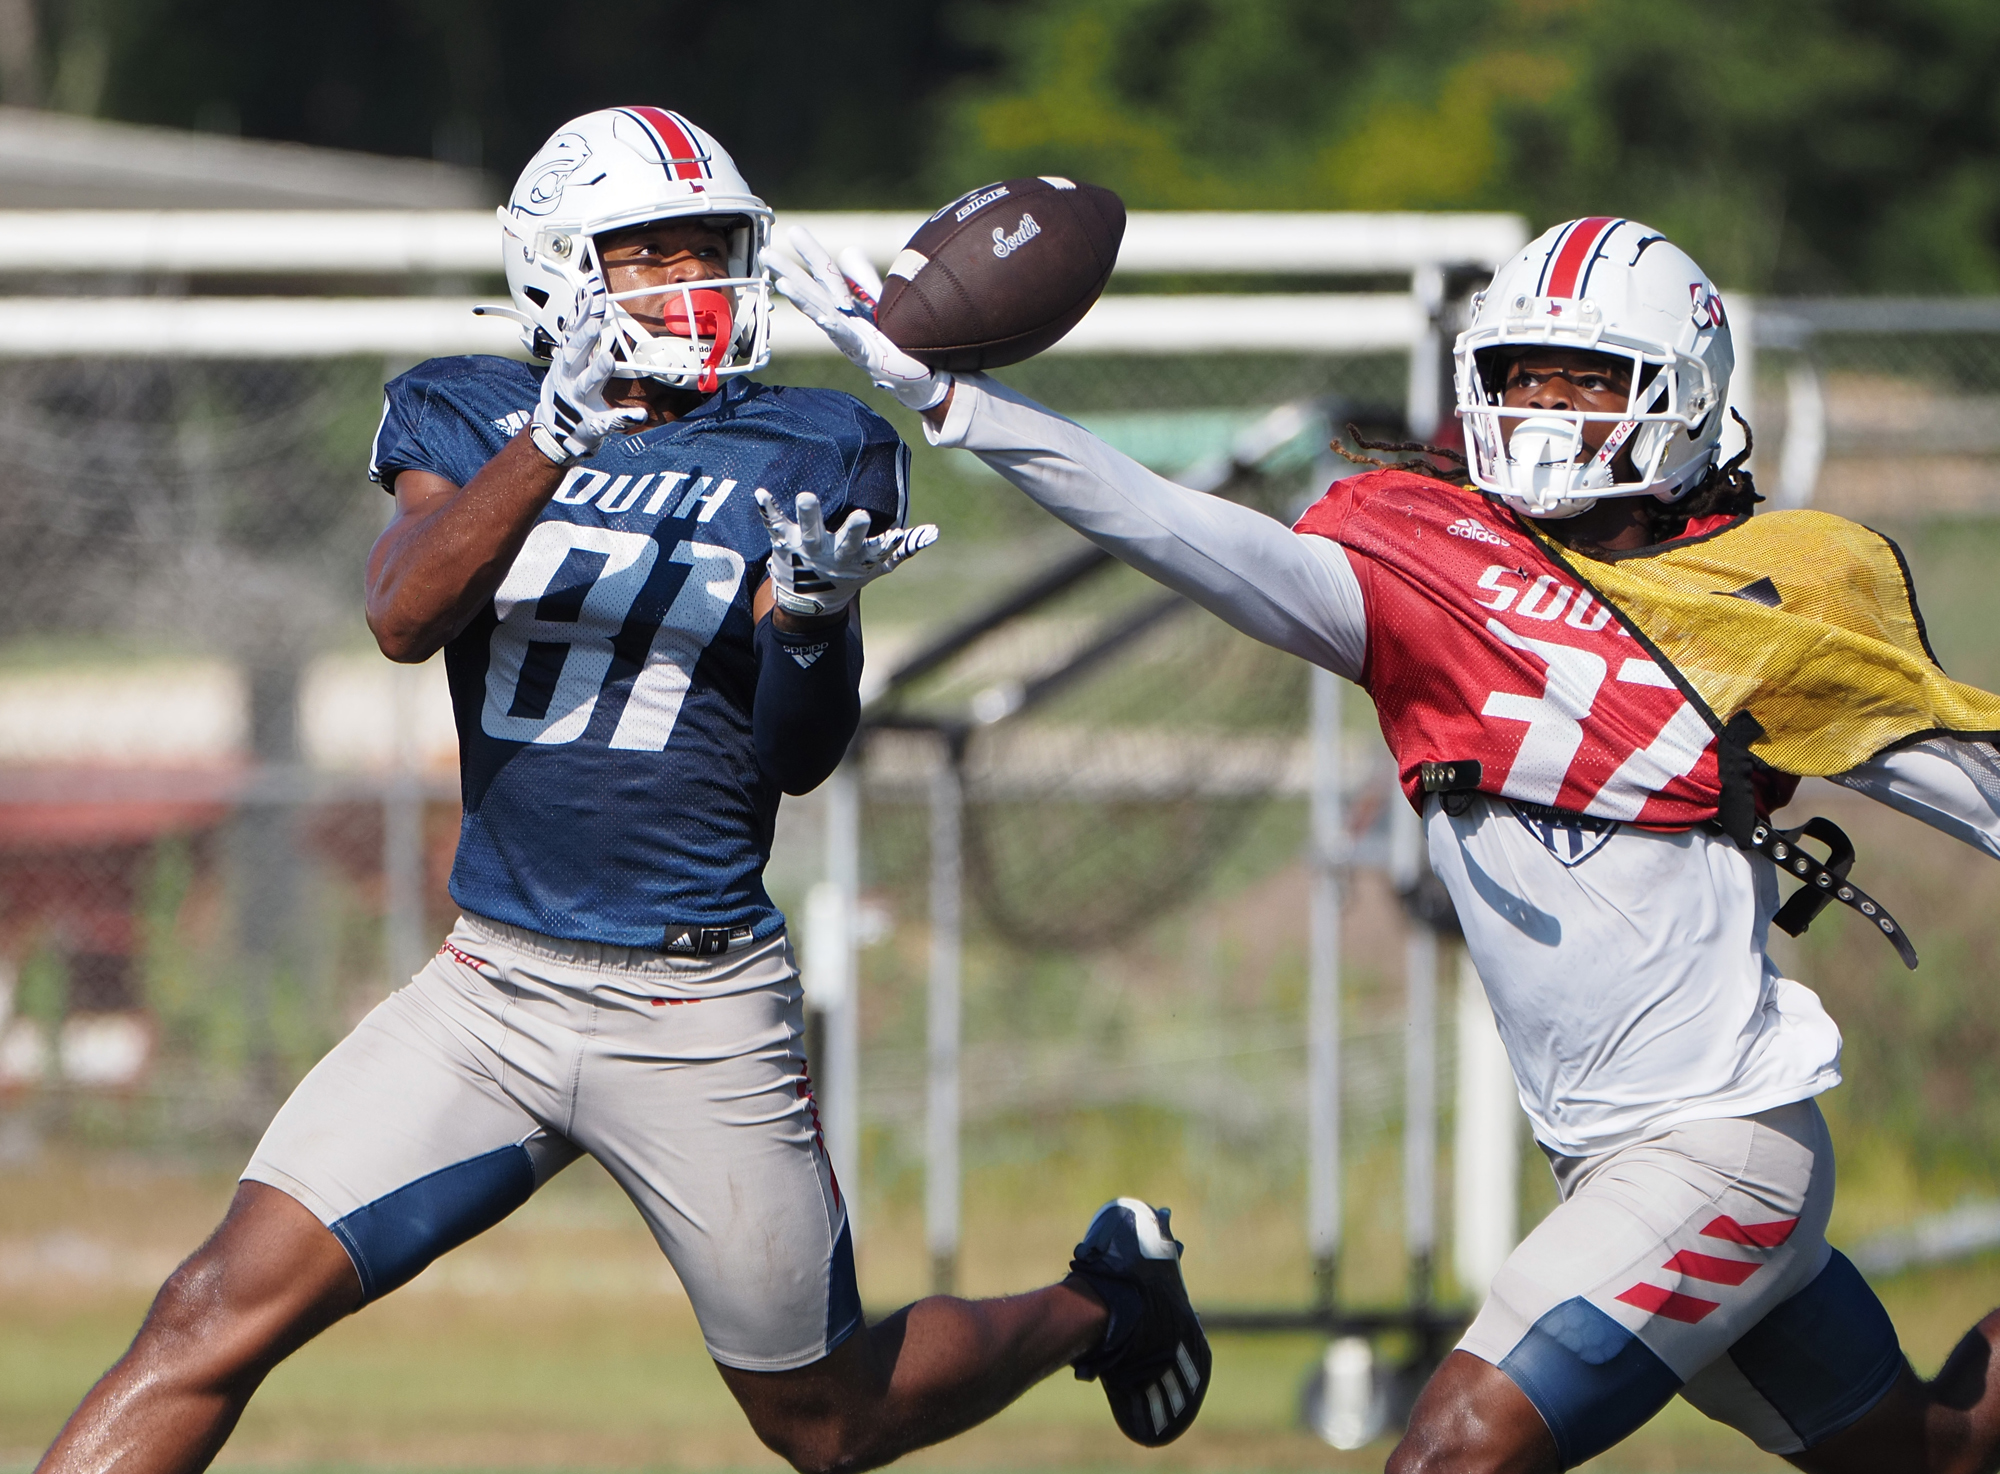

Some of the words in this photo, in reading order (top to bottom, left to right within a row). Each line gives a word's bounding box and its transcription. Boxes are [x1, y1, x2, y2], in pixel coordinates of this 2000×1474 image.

[955, 186, 1010, 222] DIME
[992, 213, 1041, 258] South
[551, 466, 737, 522] OUTH
[1472, 565, 1632, 637] SOU
[480, 520, 746, 752] 81
[783, 642, 829, 656] adidas
[1481, 618, 1716, 821] 37
